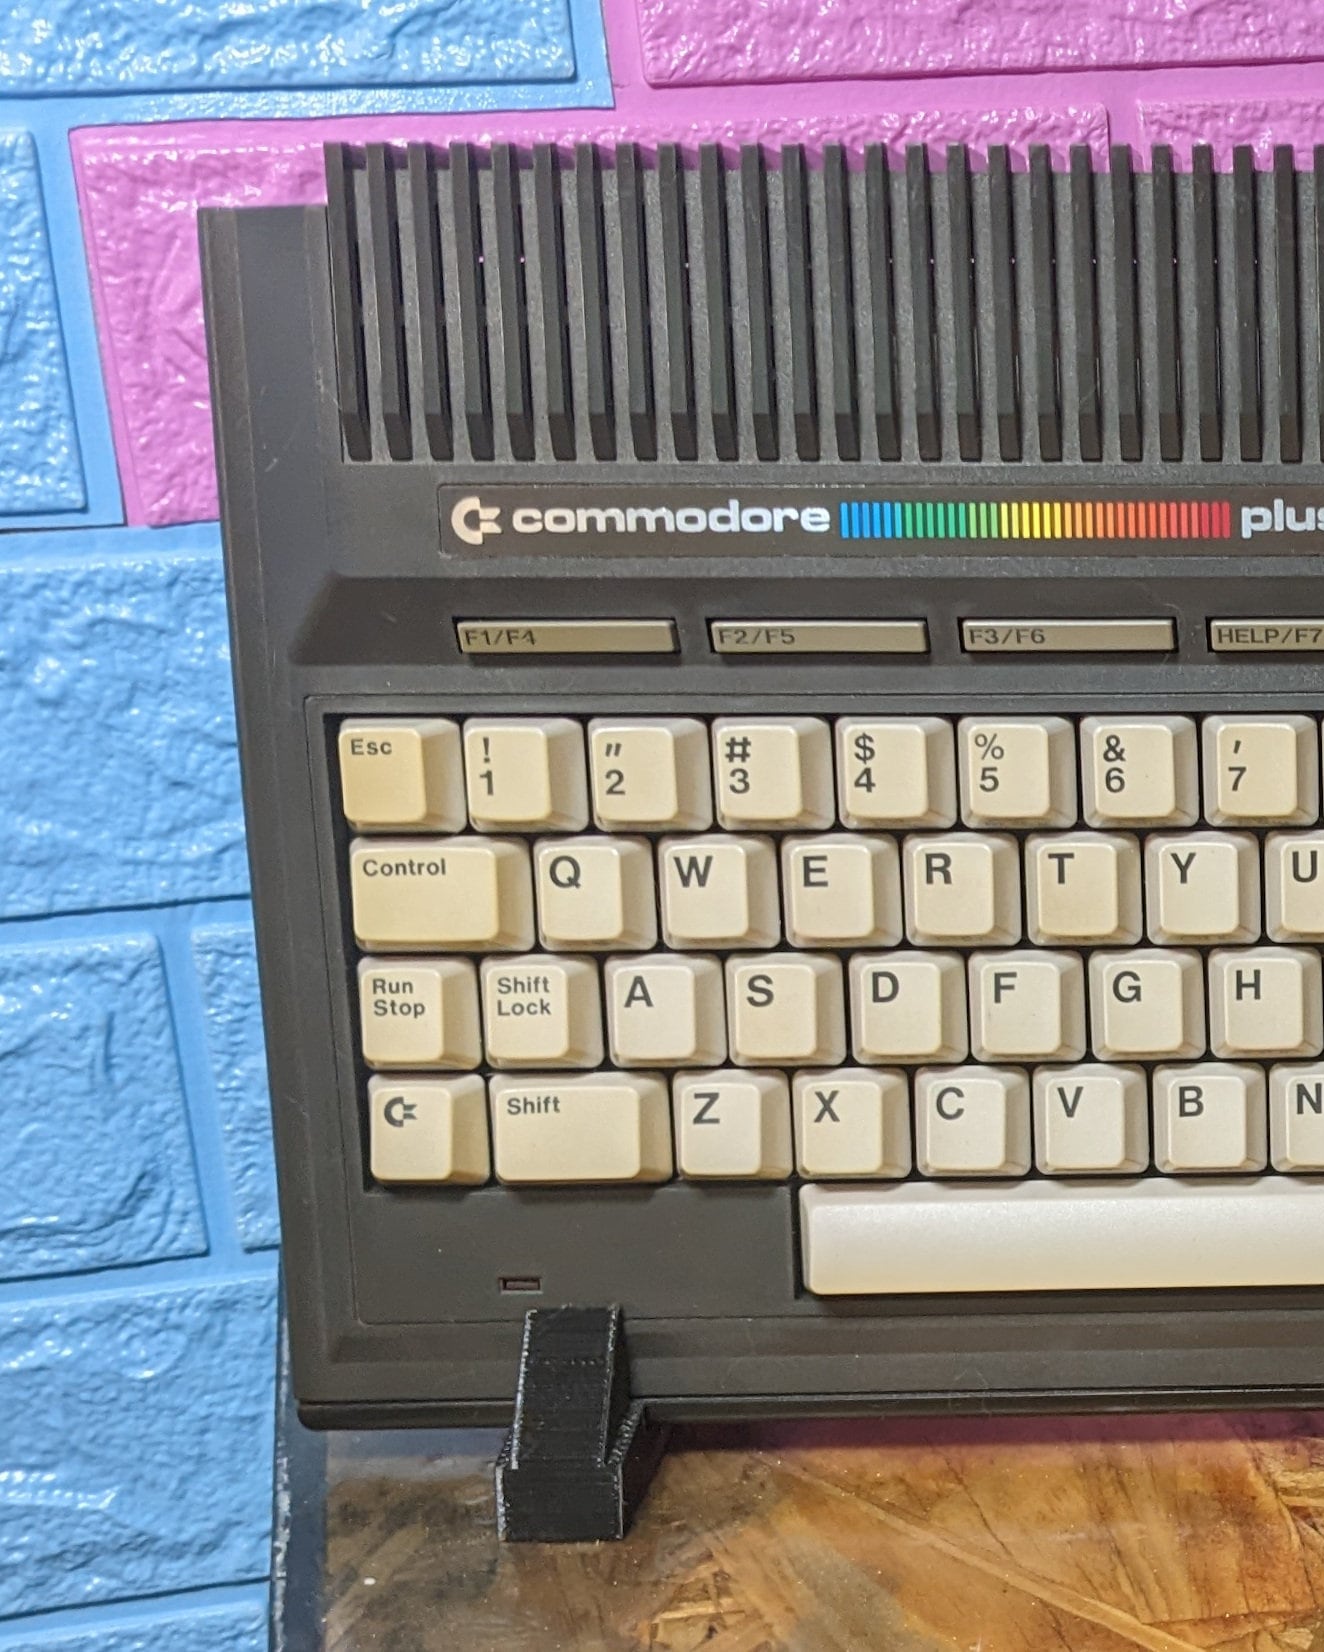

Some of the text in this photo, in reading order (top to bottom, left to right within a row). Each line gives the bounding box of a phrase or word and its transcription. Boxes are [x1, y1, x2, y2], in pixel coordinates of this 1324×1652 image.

[512, 499, 831, 533] commodore
[464, 629, 536, 646] F1/F4
[717, 627, 796, 645] F2/F5
[968, 628, 1046, 645] F3/F6
[1217, 627, 1323, 644] HELP/F7
[350, 738, 392, 756] Esc
[482, 736, 491, 764] !
[725, 736, 752, 763] #
[854, 732, 876, 765] $
[974, 733, 1005, 761] %
[1102, 734, 1126, 763] &
[479, 769, 494, 796] 1
[605, 769, 626, 795] 2
[729, 767, 750, 794] 3
[854, 767, 876, 793] 4
[979, 766, 1000, 793] 5
[1105, 767, 1125, 794] 6
[1228, 766, 1247, 792] 7
[362, 857, 446, 877] Control
[549, 855, 581, 889] Q
[673, 855, 713, 888] W
[802, 855, 829, 888] E
[925, 852, 952, 885] R
[1047, 852, 1075, 885] T
[1170, 852, 1196, 884] Y
[1292, 850, 1318, 883] U
[372, 978, 414, 995] Run
[497, 976, 550, 995] Shift
[624, 975, 654, 1008] A
[746, 974, 774, 1008] S
[871, 971, 900, 1003] D
[993, 971, 1018, 1004] F
[1112, 970, 1142, 1003] G
[1235, 969, 1261, 1001] H
[373, 999, 426, 1019] Stop
[497, 998, 551, 1017] Lock
[507, 1096, 560, 1116] Shift
[692, 1092, 720, 1125] Z
[813, 1090, 841, 1123] X
[935, 1086, 965, 1121] C
[1056, 1086, 1084, 1118] V
[1178, 1085, 1204, 1118] B
[1296, 1082, 1322, 1115] N
